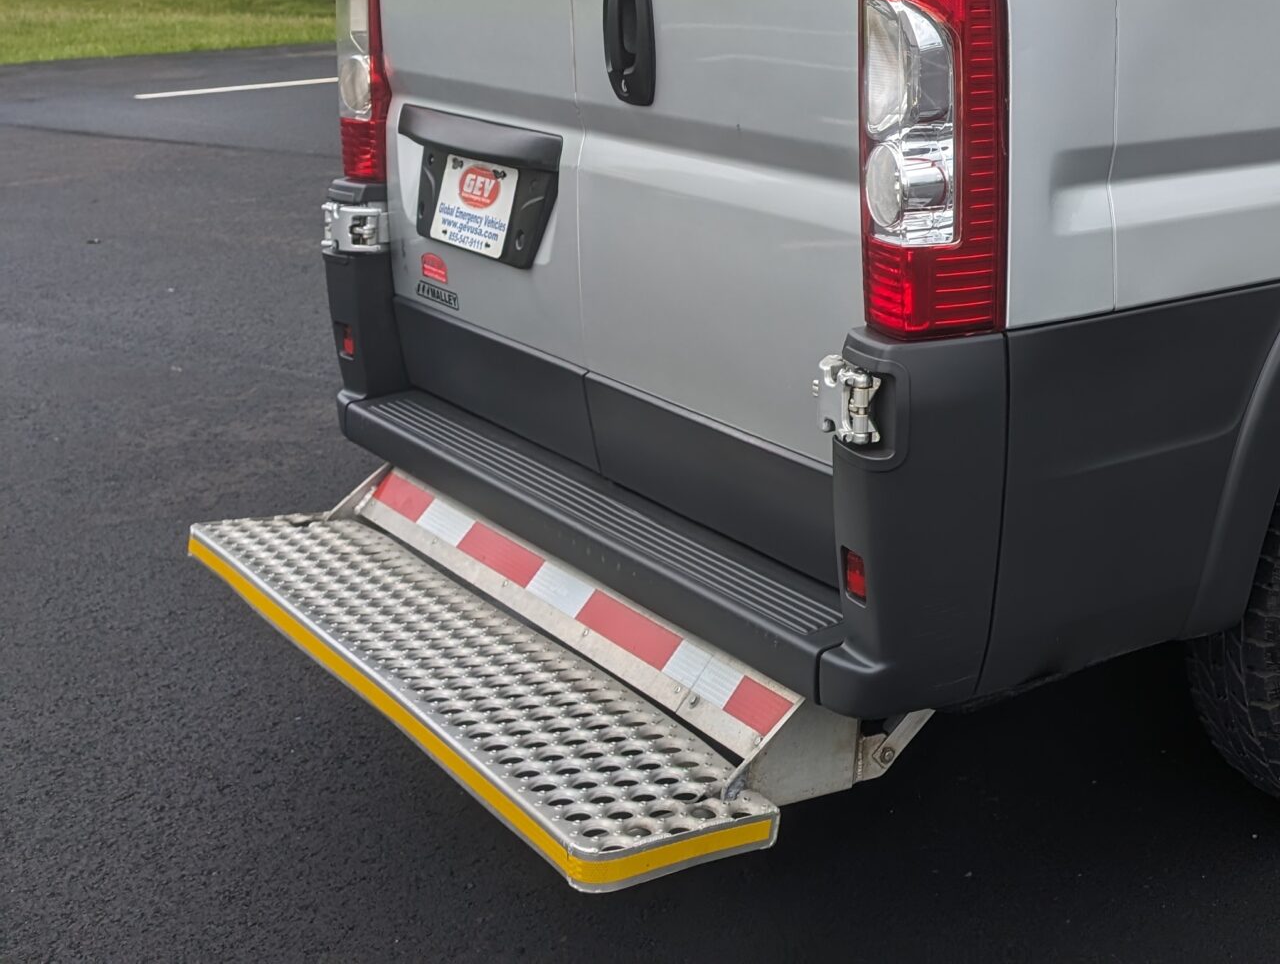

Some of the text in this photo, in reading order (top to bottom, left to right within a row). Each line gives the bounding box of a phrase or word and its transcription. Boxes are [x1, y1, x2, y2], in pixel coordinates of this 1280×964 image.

[464, 174, 496, 197] GEV
[439, 203, 506, 232] Global Emergency Vehicles
[441, 218, 499, 241] www.gevusa.com
